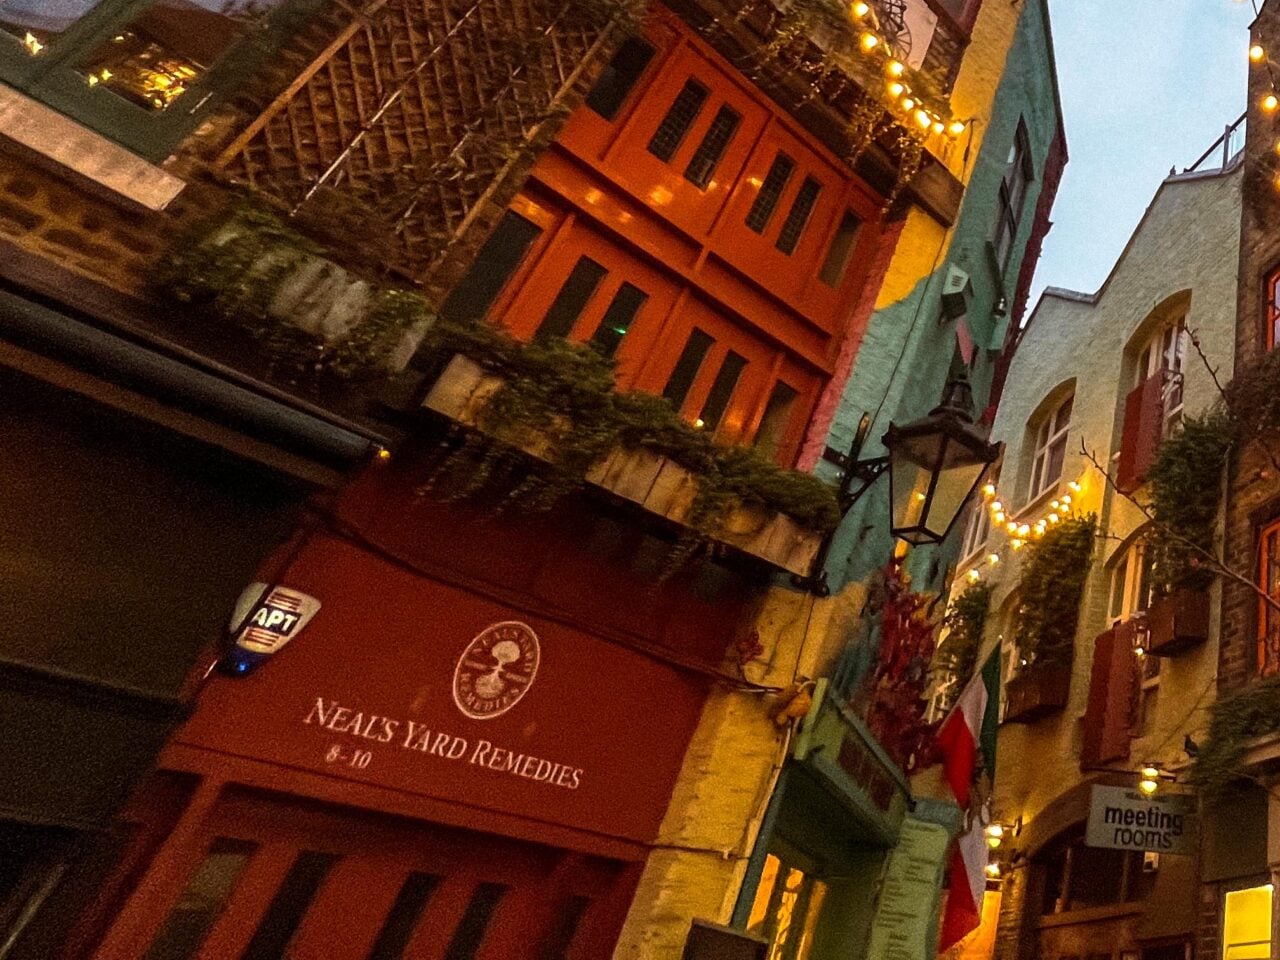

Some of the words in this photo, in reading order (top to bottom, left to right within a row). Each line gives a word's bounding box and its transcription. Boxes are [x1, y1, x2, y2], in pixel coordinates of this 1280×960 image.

[250, 607, 298, 632] APT
[302, 696, 399, 744] NEAL'S
[402, 719, 468, 761] YARD
[471, 739, 585, 791] REMEDIES
[1104, 806, 1184, 836] meeting
[1114, 828, 1172, 850] rooms
